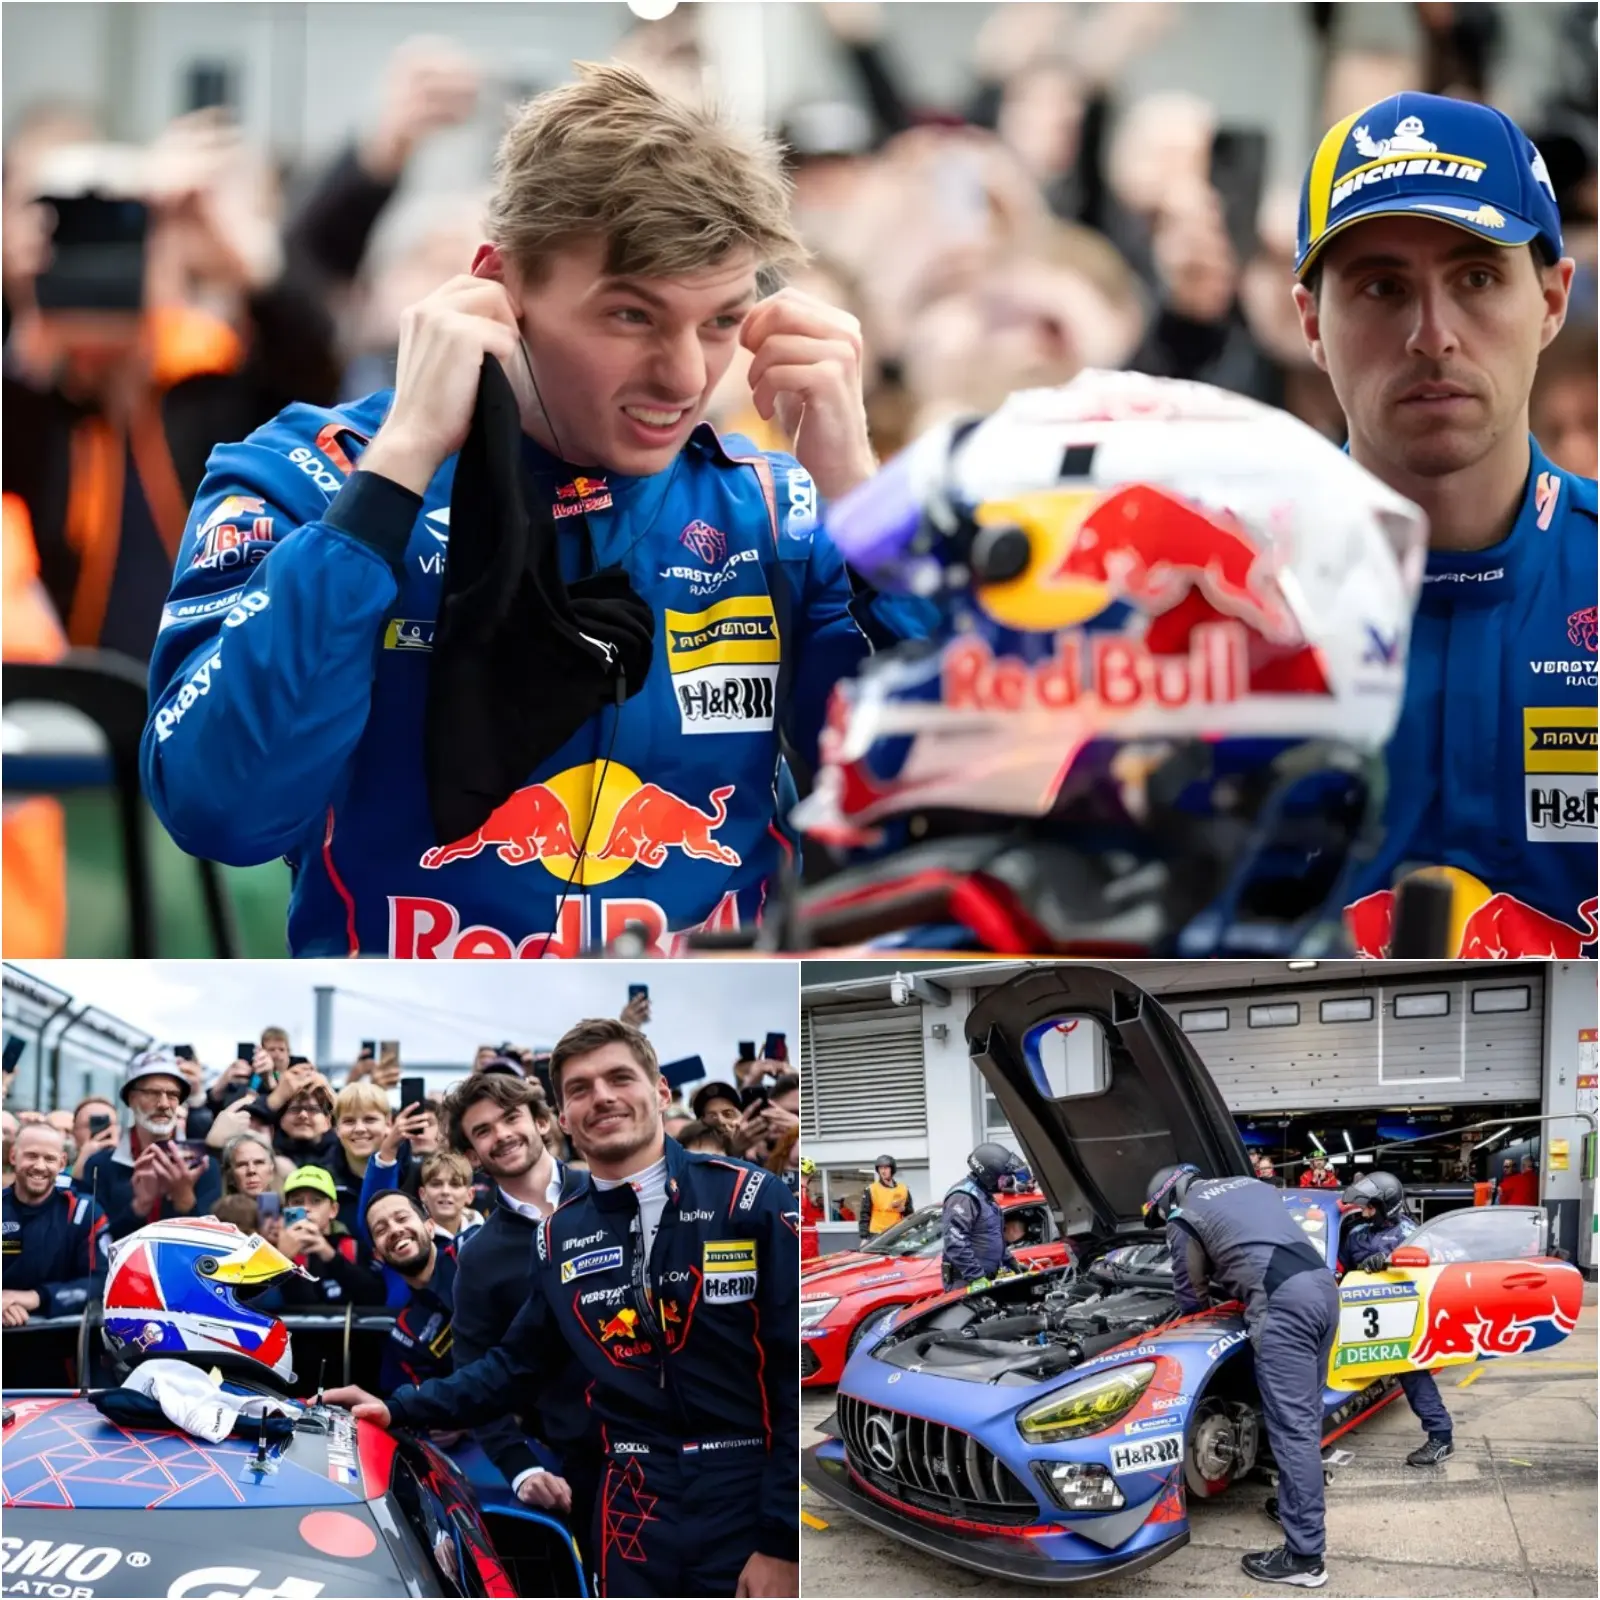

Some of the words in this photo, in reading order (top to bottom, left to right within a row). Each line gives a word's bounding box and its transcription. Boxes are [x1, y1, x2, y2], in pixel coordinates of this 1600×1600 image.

[1331, 159, 1483, 209] MICHELIN
[941, 632, 1090, 712] Red
[1092, 619, 1249, 709] Bull
[387, 894, 592, 958] Red
[1342, 1284, 1412, 1300] RAVENOL
[1362, 1307, 1379, 1339] 3
[1346, 1344, 1403, 1364] DEKRA
[1116, 1443, 1156, 1468] H&R
